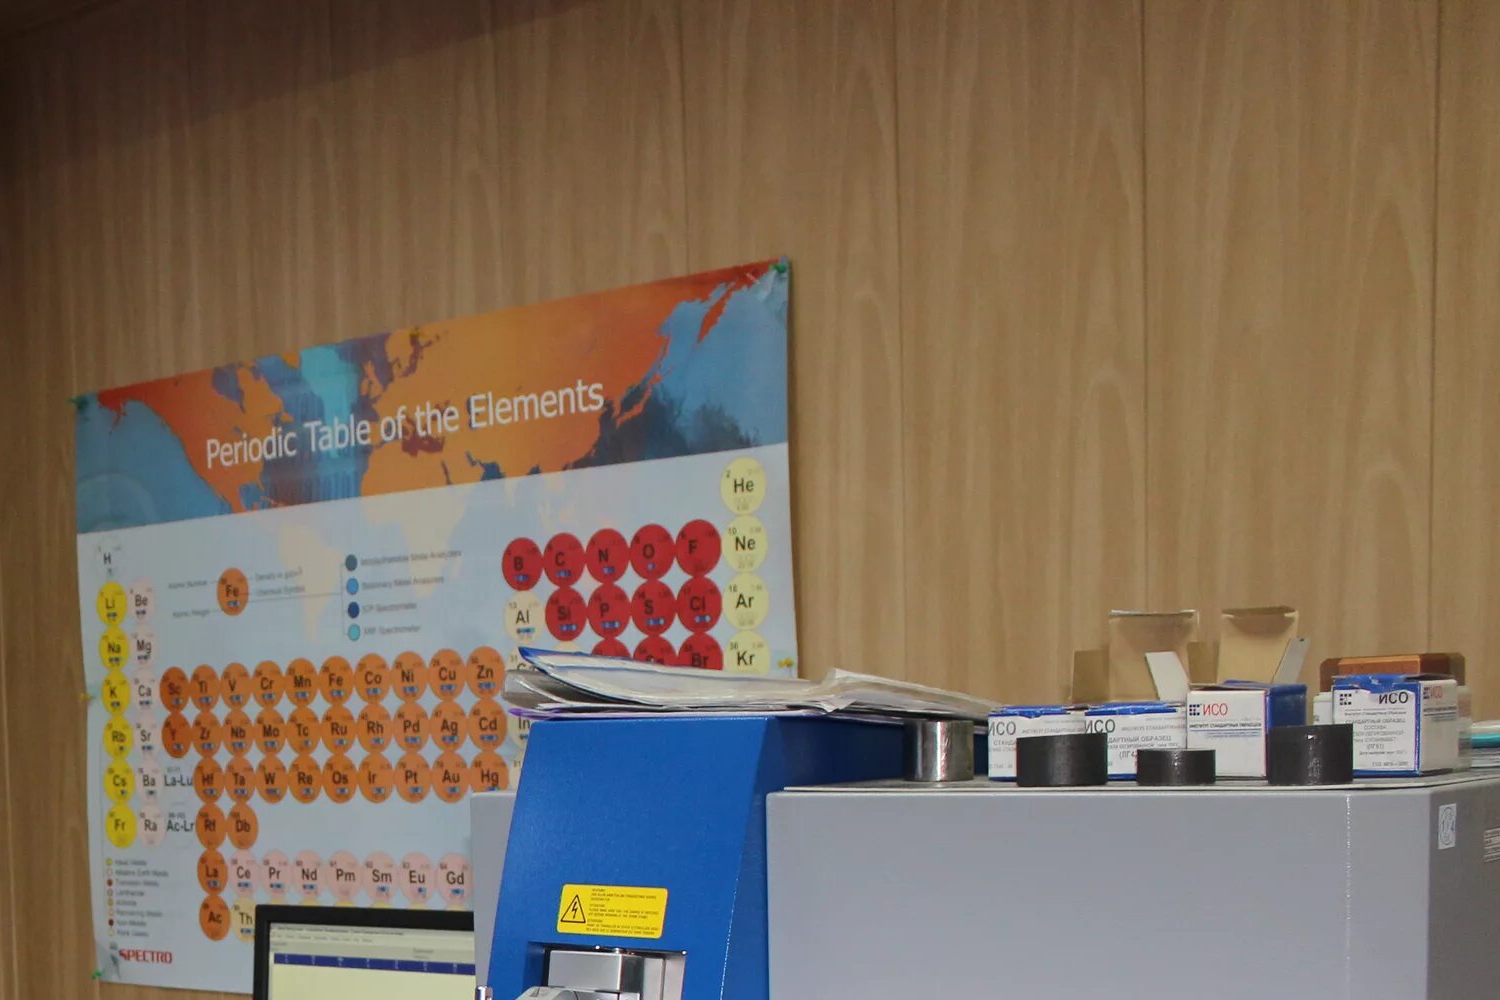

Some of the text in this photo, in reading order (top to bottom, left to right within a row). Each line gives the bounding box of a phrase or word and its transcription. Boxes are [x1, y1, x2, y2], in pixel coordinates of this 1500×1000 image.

[206, 378, 605, 469] Periodic Table of the Elements
[733, 477, 754, 494] He
[688, 539, 698, 554] F
[735, 536, 756, 551] Ne
[598, 548, 609, 563] N
[643, 543, 655, 559] O
[103, 552, 112, 565] H
[514, 556, 524, 571] B
[555, 551, 565, 567] C
[225, 584, 240, 598] Fe
[135, 594, 148, 607] Be
[644, 599, 654, 615] S
[690, 595, 706, 611] Cl
[735, 592, 755, 609] Ar
[515, 609, 530, 624] Al
[557, 605, 571, 620] Si
[600, 603, 609, 617] P
[108, 642, 122, 654] Na
[137, 639, 152, 655] Mg
[737, 650, 756, 666] Kr
[364, 670, 382, 685] Co
[401, 669, 414, 683] Ni
[438, 666, 456, 681] Cu
[476, 664, 494, 679] Zn
[228, 679, 237, 692] V
[260, 677, 274, 690] Cr
[294, 675, 312, 688] Mn
[328, 672, 343, 687] Fe
[109, 686, 117, 698] K
[138, 684, 152, 697] Ca
[1379, 691, 1409, 705] ИСО
[1203, 703, 1228, 716] ИСО
[263, 725, 280, 737] Mo
[296, 723, 309, 737] Tc
[330, 722, 348, 736] Ru
[367, 720, 384, 734] Rh
[403, 719, 420, 734] Pd
[441, 718, 458, 736] Ag
[479, 717, 498, 731] Cd
[1085, 719, 1116, 734] ИСО
[112, 730, 126, 742] Rb
[140, 729, 152, 742] Sr
[231, 727, 245, 738] Nb
[113, 774, 127, 787] Cs
[143, 775, 156, 786] Ba
[164, 774, 193, 787] La-Lu
[202, 773, 214, 785] Hf
[233, 773, 246, 786] Ta
[264, 772, 276, 784] W
[297, 771, 313, 785] Re
[332, 770, 349, 785] Os
[368, 771, 377, 784] Ir
[404, 769, 418, 784] Pt
[442, 769, 460, 784] Au
[481, 769, 499, 787] Hg
[114, 819, 125, 831] Fr
[144, 820, 157, 831] Ra
[167, 820, 194, 832] Ac-Lr
[204, 819, 216, 831] Rf
[235, 820, 251, 832] Db
[205, 865, 218, 878] La
[237, 866, 251, 879] Ce
[269, 867, 280, 880] Pr
[302, 868, 318, 881] Nd
[336, 868, 356, 882] Pm
[372, 869, 392, 883] Sm
[409, 870, 426, 884] Eu
[446, 871, 464, 885] Gd
[208, 911, 222, 924] Ac
[239, 912, 253, 925] Th
[119, 948, 173, 965] SPECTRO
